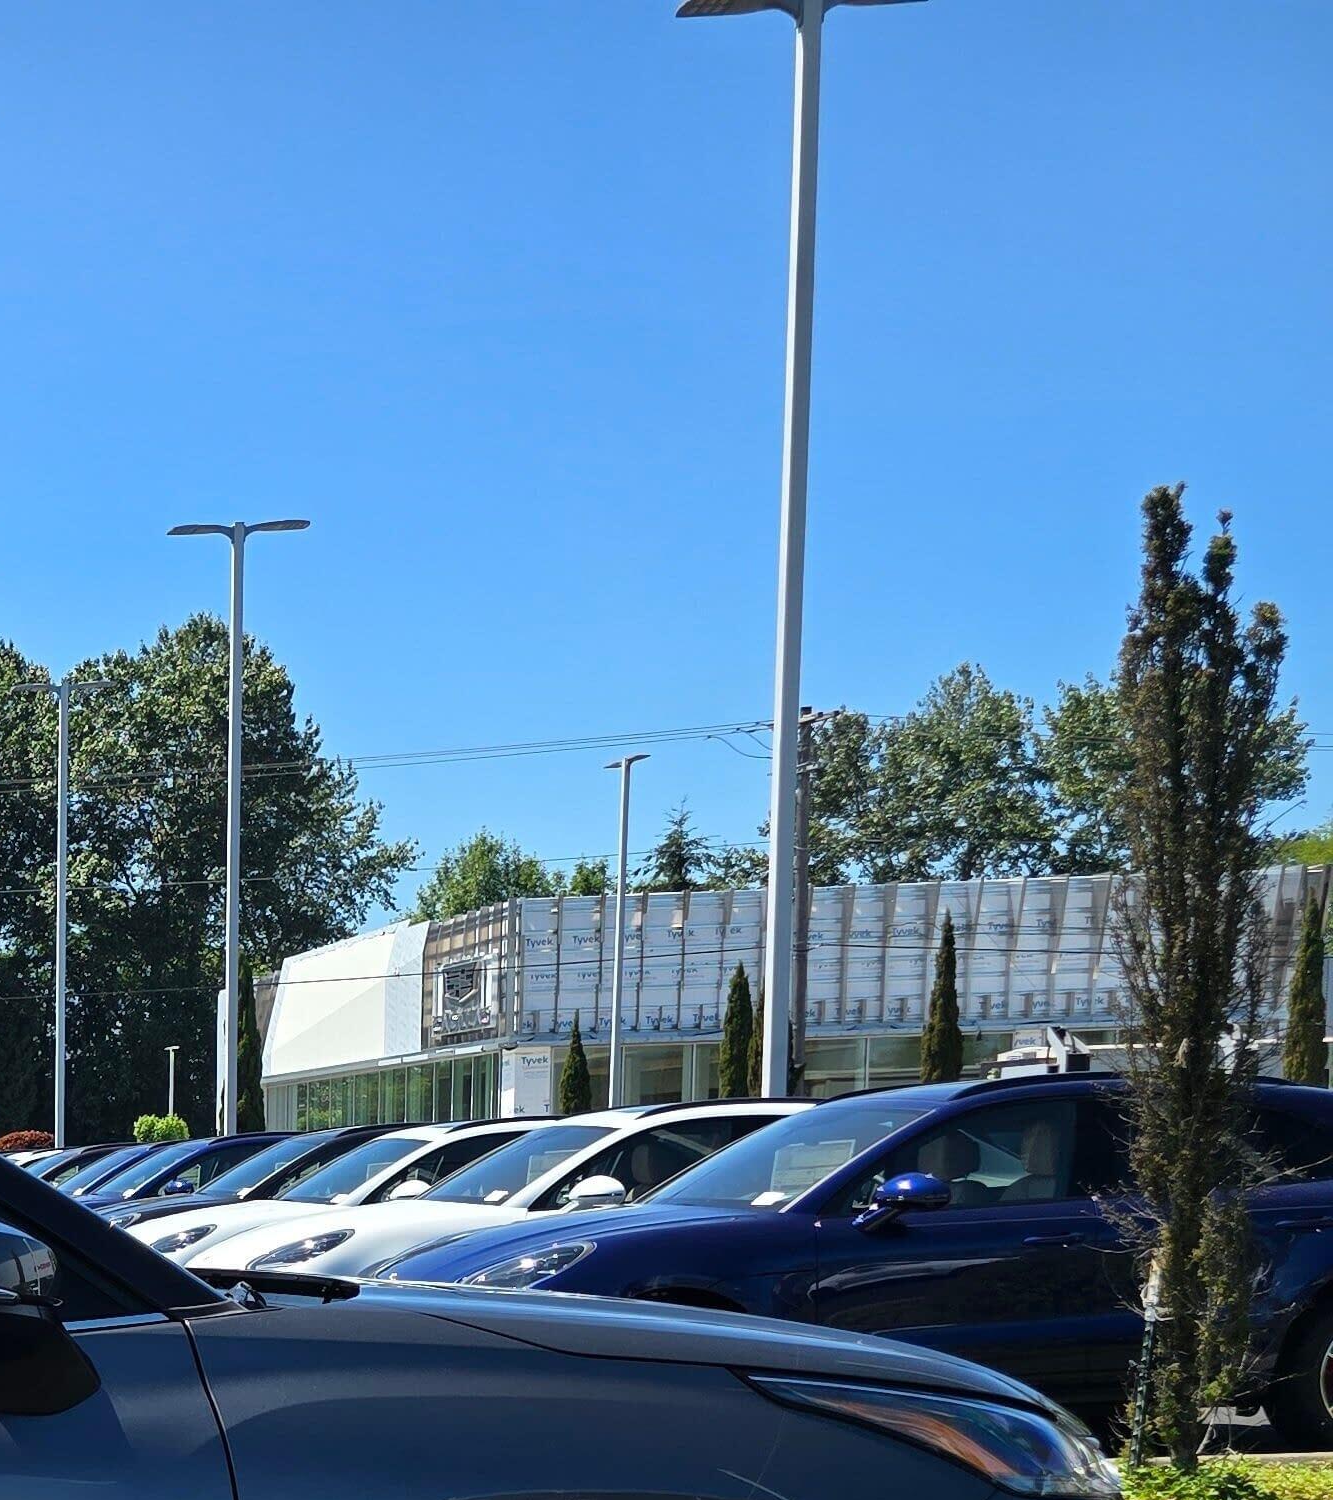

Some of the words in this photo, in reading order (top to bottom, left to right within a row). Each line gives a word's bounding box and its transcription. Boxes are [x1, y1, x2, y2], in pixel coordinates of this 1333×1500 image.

[715, 926, 742, 936] Tyek
[525, 937, 554, 948] Tyvek
[573, 935, 601, 946] Tyvek
[521, 1055, 549, 1067] Tyvek
